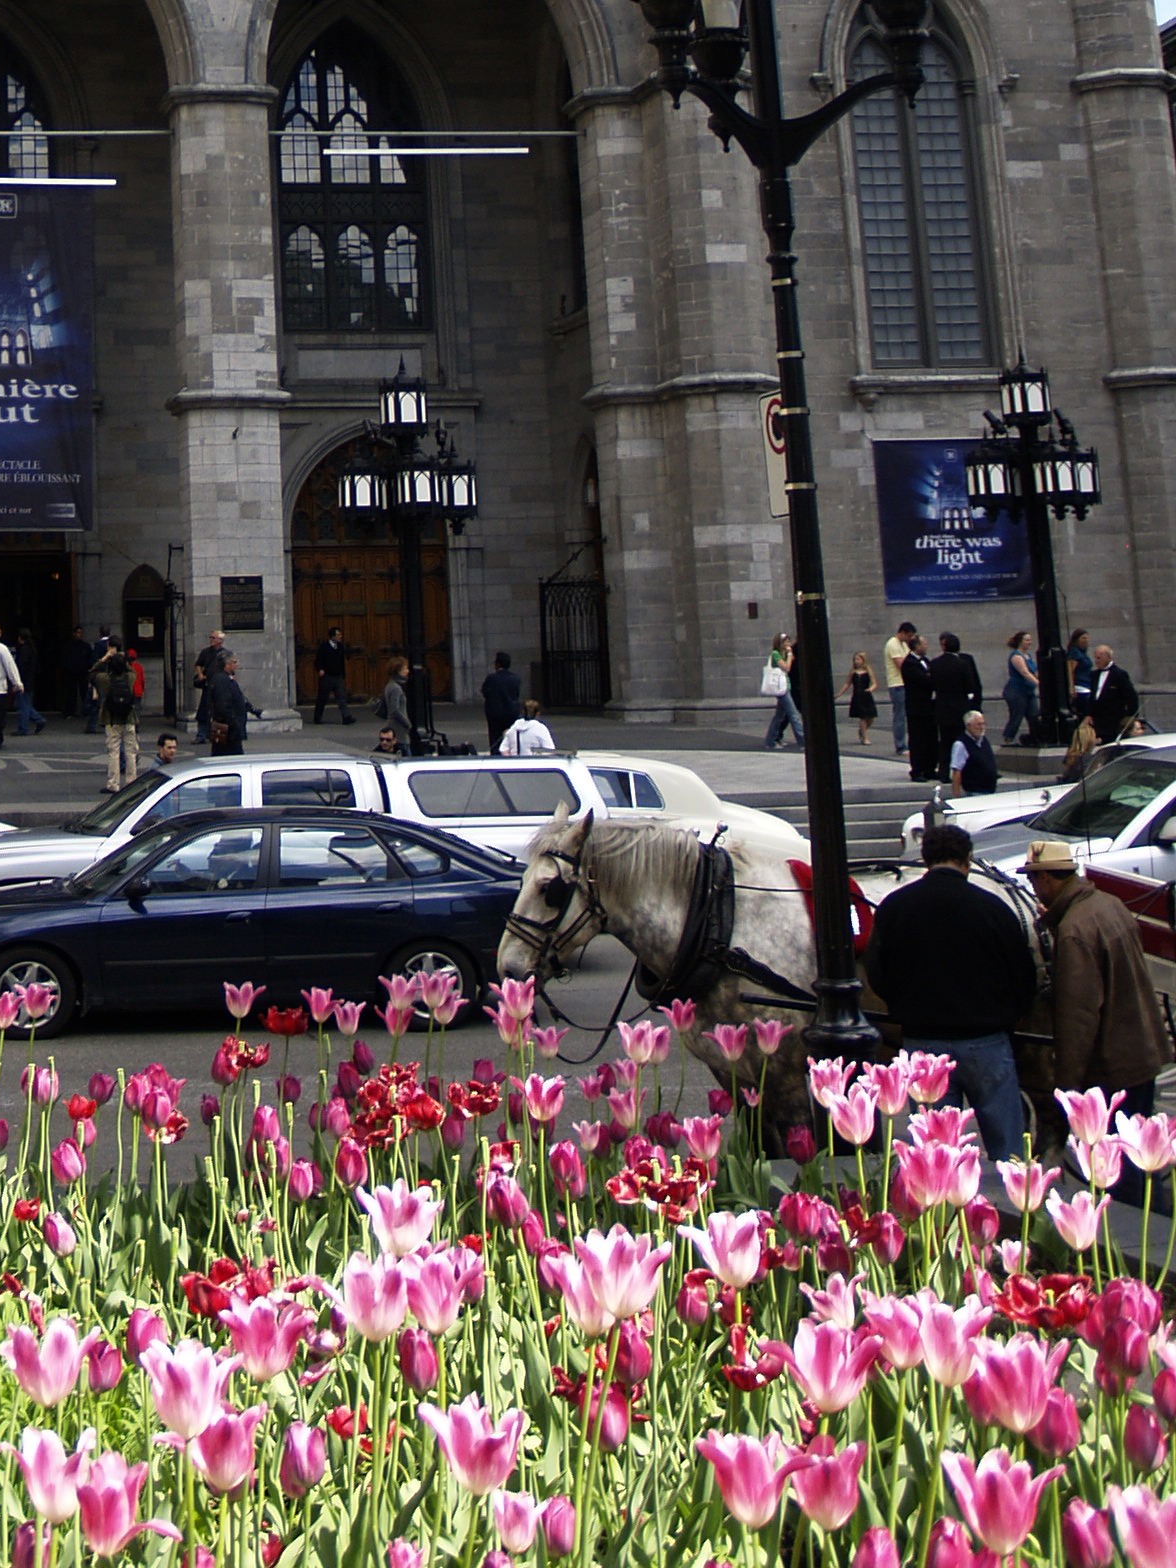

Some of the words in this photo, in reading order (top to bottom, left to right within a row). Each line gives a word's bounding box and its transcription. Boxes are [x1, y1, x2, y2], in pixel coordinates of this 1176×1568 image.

[915, 534, 963, 549] there
[965, 536, 1003, 548] was
[935, 548, 985, 571] light
